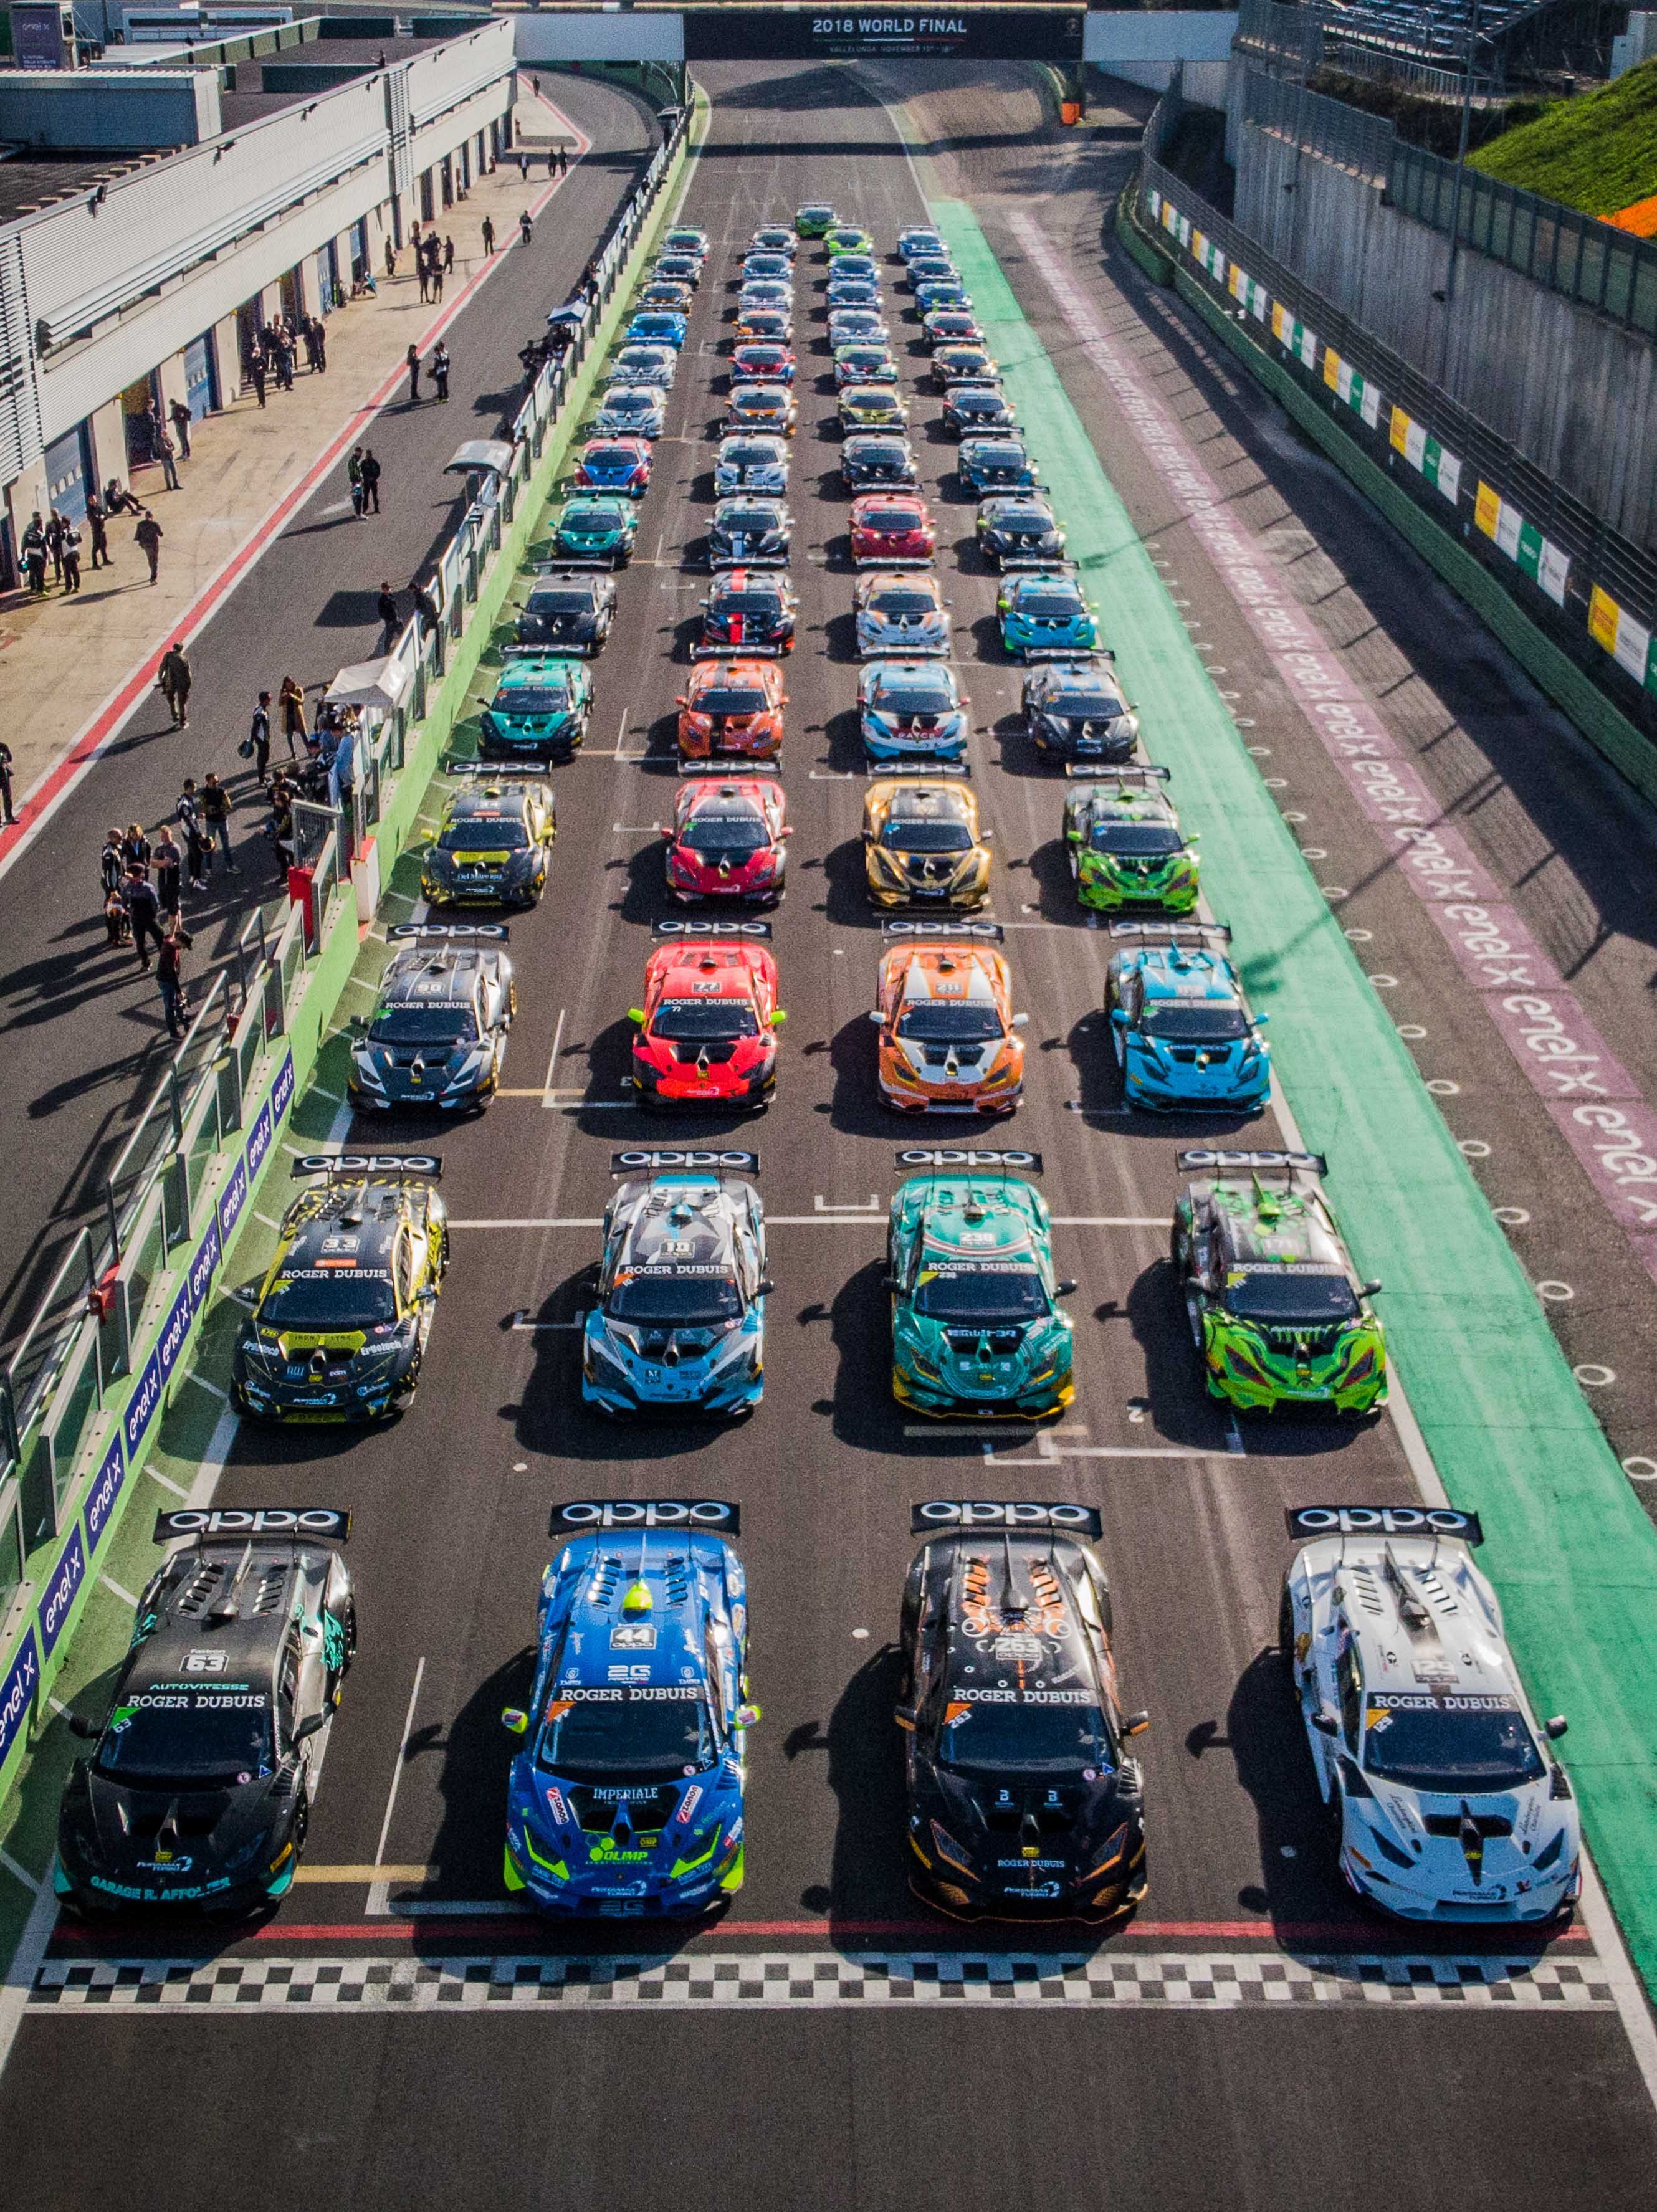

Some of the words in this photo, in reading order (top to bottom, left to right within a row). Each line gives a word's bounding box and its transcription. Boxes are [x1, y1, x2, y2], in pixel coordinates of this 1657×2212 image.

[813, 19, 853, 32] 2018
[859, 19, 914, 32] WORLD
[919, 19, 967, 32] FINAL
[1255, 608, 1309, 636] enel
[1275, 639, 1309, 649] x
[1283, 654, 1341, 685] enel
[1306, 687, 1343, 700] x
[1316, 703, 1379, 740] enel
[1340, 743, 1382, 756] x
[453, 763, 545, 772] oppo
[1352, 760, 1421, 803] enel
[1380, 806, 1424, 822] x
[1394, 827, 1479, 876] enel
[1427, 879, 1476, 897] x
[394, 925, 503, 937] oppo
[659, 922, 766, 933] oppo
[889, 922, 997, 934] oppo
[1444, 904, 1531, 960] enel
[1482, 966, 1535, 986] x
[697, 982, 718, 991] 77
[427, 1001, 470, 1009] DUBUIS
[1502, 995, 1600, 1062] enel
[274, 1077, 289, 1112] enel
[287, 1062, 292, 1080] x
[1549, 1071, 1607, 1094] x
[250, 1128, 264, 1168] enel
[262, 1115, 270, 1133] x
[1572, 1105, 1657, 1185] enel
[302, 1157, 435, 1171] oppo
[620, 1151, 752, 1166] oppo
[902, 1150, 1034, 1166] oppo
[223, 1186, 238, 1228] enel
[237, 1171, 245, 1190] x
[325, 1237, 358, 1248] 33
[193, 1255, 211, 1296] enel
[209, 1235, 217, 1253] x
[625, 1265, 672, 1275] ROGER
[676, 1265, 728, 1274] DUBUIS
[928, 1262, 977, 1272] ROGER
[981, 1262, 1034, 1273] DUBUIS
[1233, 1263, 1282, 1274] ROGER
[282, 1270, 329, 1279] ROGER
[335, 1270, 387, 1279] DUBUIS
[162, 1317, 181, 1365] enel
[180, 1299, 189, 1326] x
[129, 1383, 150, 1441] enel
[148, 1369, 158, 1396] x
[90, 1467, 113, 1532] enel
[112, 1453, 123, 1477] x
[169, 1510, 340, 1532] oppo
[561, 1502, 730, 1526] oppo
[920, 1501, 1090, 1525] oppo
[1298, 1509, 1467, 1532] oppo
[46, 1565, 70, 1633] enel
[70, 1547, 80, 1576] x
[614, 1628, 651, 1642] 44
[996, 1639, 1039, 1652] 263
[186, 1656, 225, 1672] 63
[149, 1683, 249, 1691] AUTOVITESSE
[561, 1688, 623, 1701] ROGER
[629, 1687, 698, 1701] DUBUIS
[0, 1671, 24, 1746] enel
[24, 1652, 35, 1685] x
[127, 1695, 189, 1708] ROGER
[195, 1695, 265, 1708] DUBUIS
[953, 1689, 1016, 1702] ROGER
[1023, 1690, 1091, 1703] DUBUIS
[1374, 1695, 1439, 1709] ROGER
[1443, 1696, 1511, 1709] DUBUIS
[113, 1717, 132, 1734] 63
[948, 1710, 973, 1729] 263
[1372, 1715, 1394, 1733] 129
[593, 1787, 659, 1800] IMPERIALE
[682, 1785, 699, 1812] zanon
[603, 1851, 649, 1861] OLIMP
[997, 1859, 1028, 1867] ROGER
[1031, 1859, 1065, 1868] DUBUIS
[90, 1876, 140, 1899] GARAGE
[143, 1889, 158, 1900] R.
